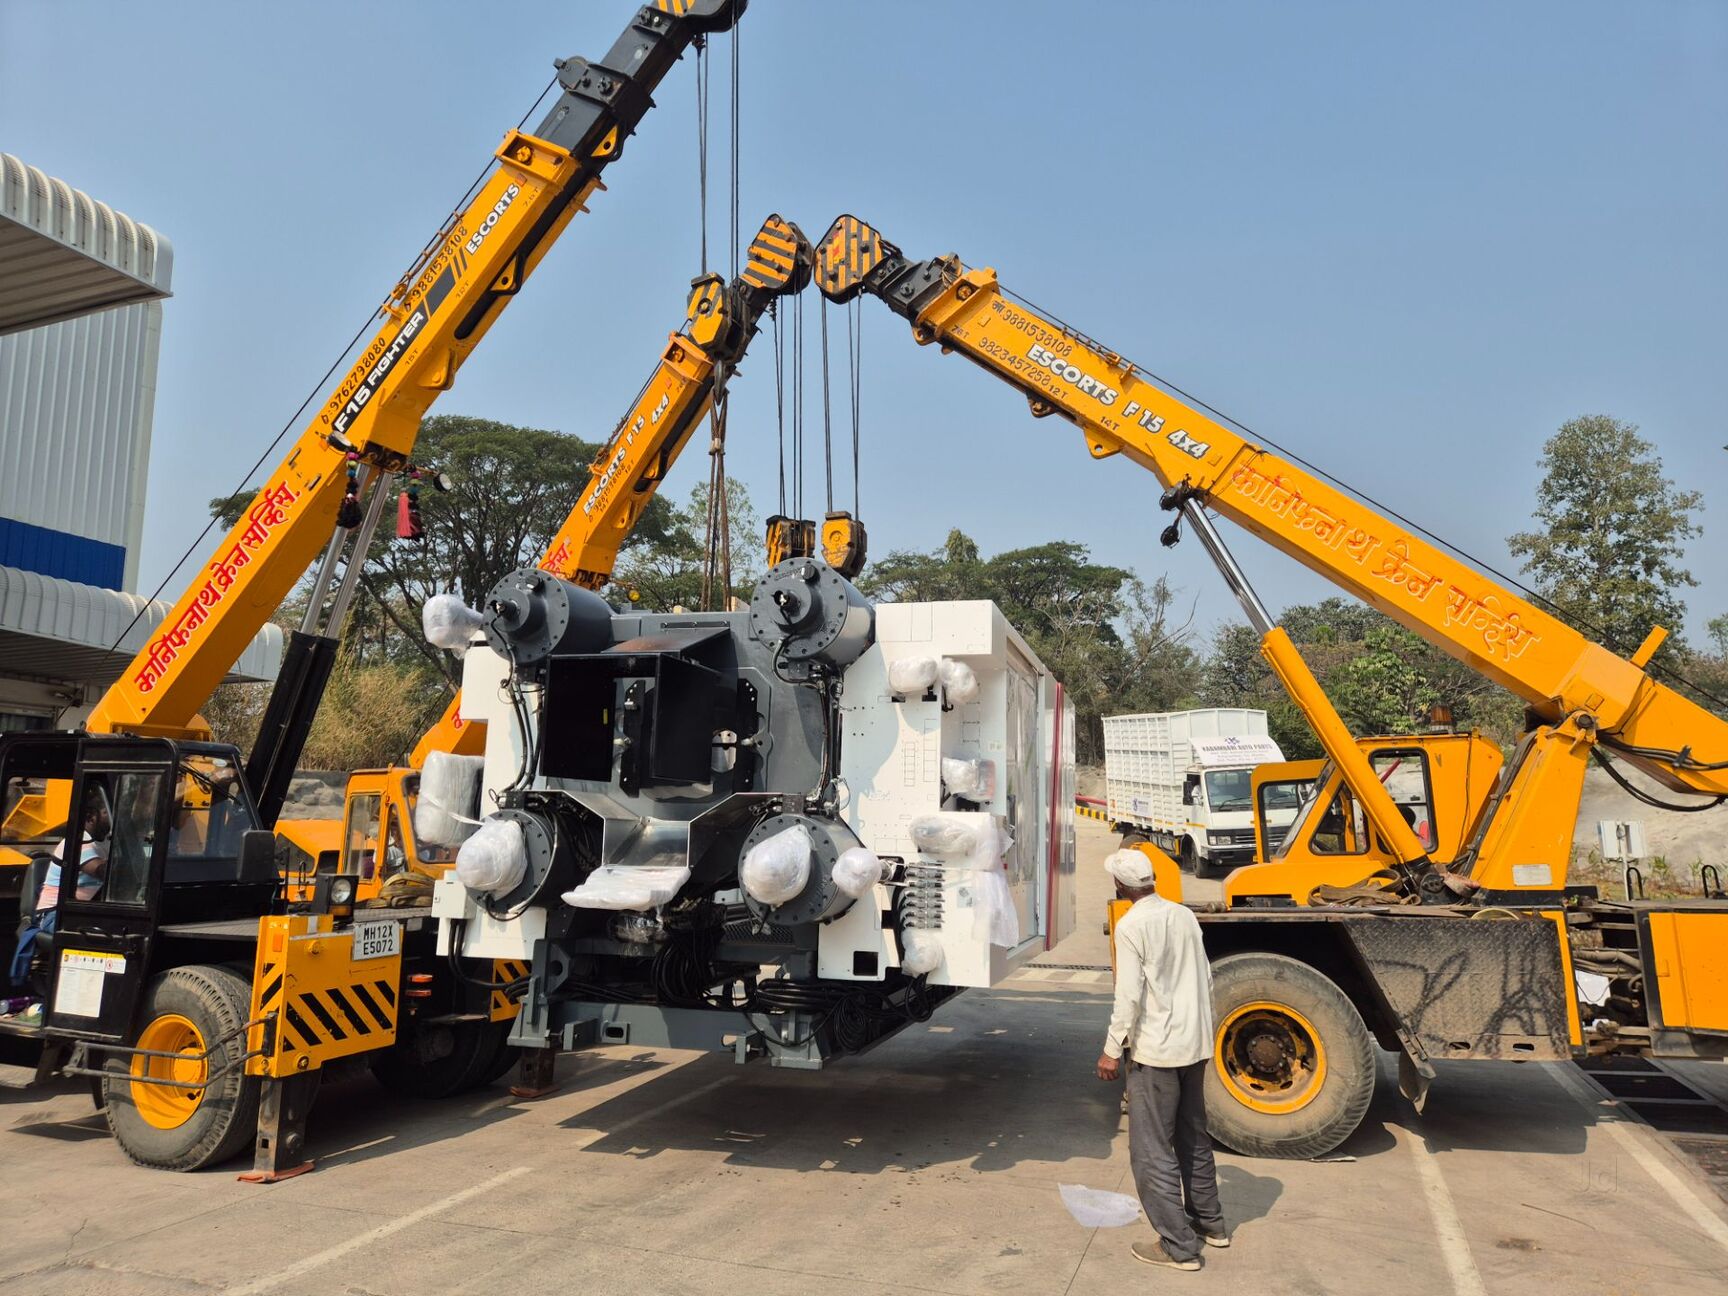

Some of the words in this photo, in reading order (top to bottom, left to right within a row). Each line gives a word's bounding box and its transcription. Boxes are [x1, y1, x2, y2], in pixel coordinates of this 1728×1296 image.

[465, 183, 520, 256] ESCORTS
[333, 384, 371, 433] F15
[367, 311, 424, 386] FIGHTER
[978, 337, 1051, 386] 9823457258
[1025, 343, 1119, 405] ESCORTS
[583, 447, 626, 516] ESCORTS
[134, 579, 223, 694] कानिफनाथ
[209, 542, 253, 593] क्रेन
[363, 924, 393, 940] MH12X
[363, 939, 393, 955] E5072
